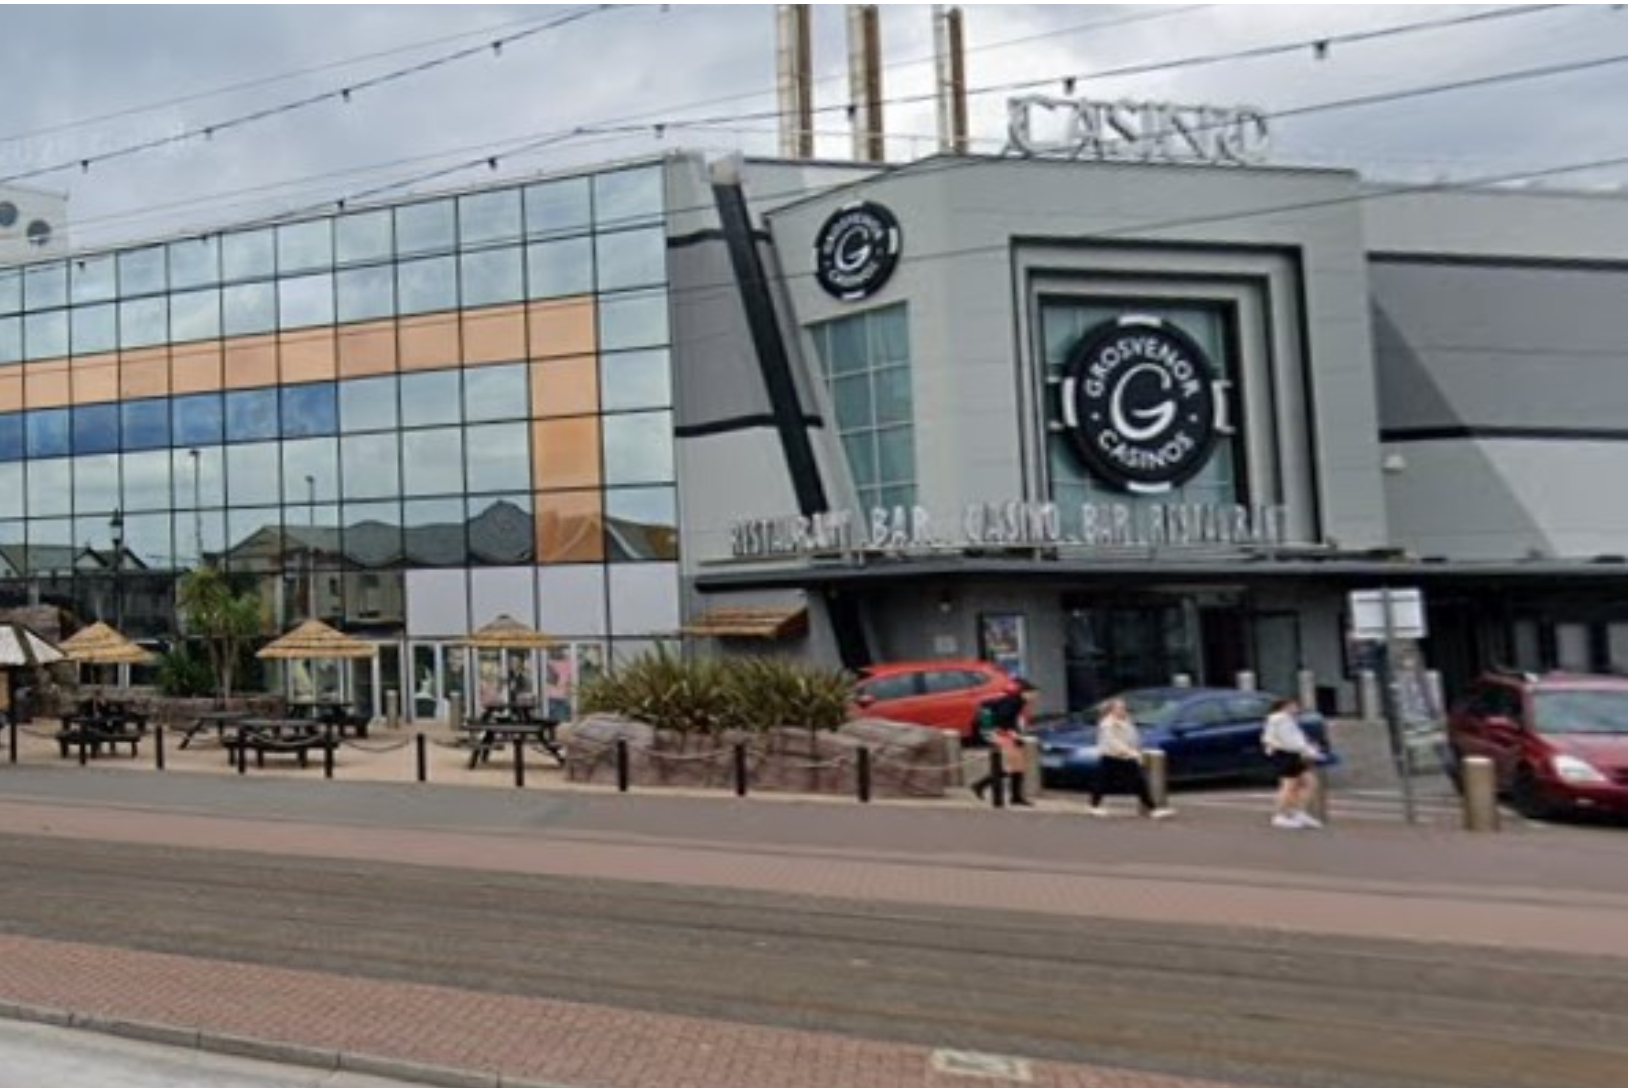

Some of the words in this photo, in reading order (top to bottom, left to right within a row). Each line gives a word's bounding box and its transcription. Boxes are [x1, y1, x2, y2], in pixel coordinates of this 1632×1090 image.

[1008, 95, 1269, 166] CASINO
[1084, 335, 1202, 398] GROSVENOR
[1110, 362, 1177, 441] G
[1097, 429, 1196, 468] CASINOS
